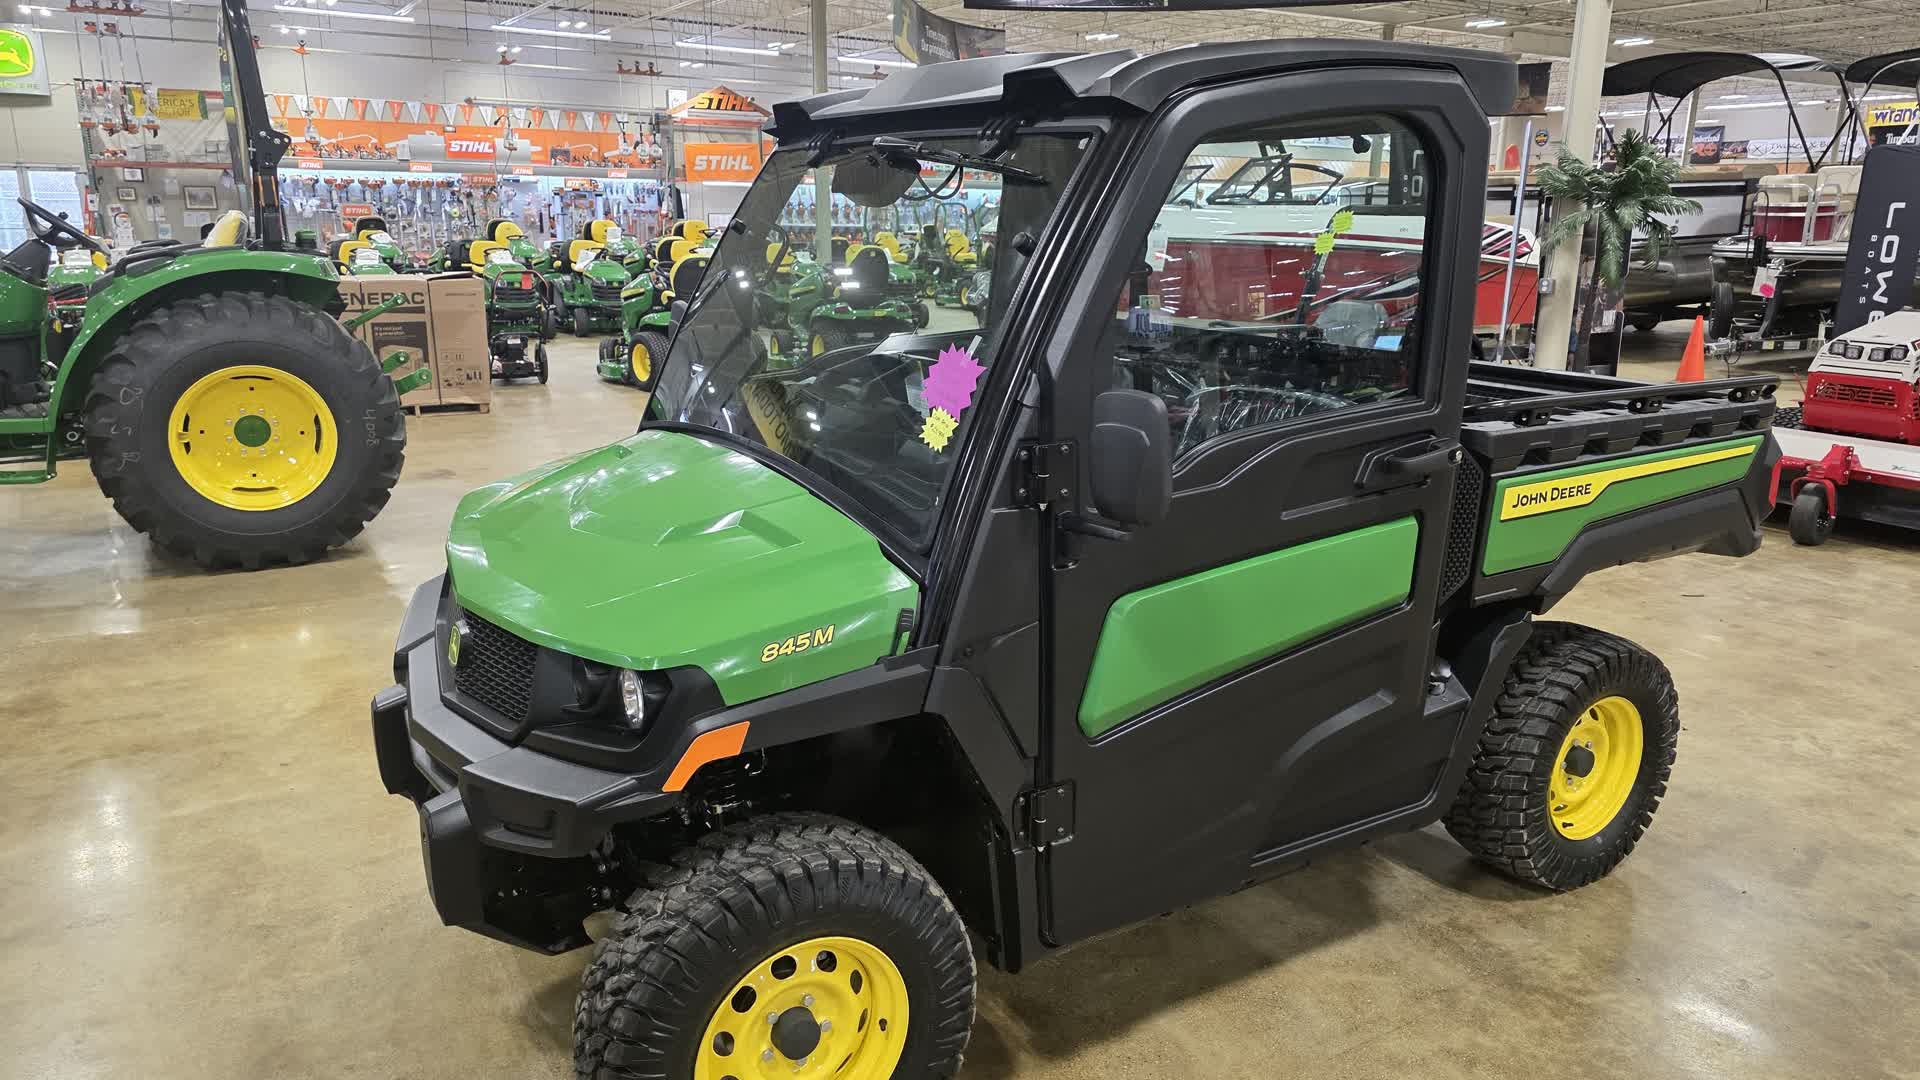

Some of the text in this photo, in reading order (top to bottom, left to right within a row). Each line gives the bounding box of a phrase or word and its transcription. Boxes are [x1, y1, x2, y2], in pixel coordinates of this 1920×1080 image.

[693, 94, 753, 111] STIHL
[449, 140, 494, 153] STIHL
[694, 155, 753, 170] STIHL
[344, 206, 370, 215] STIHL
[1858, 234, 1879, 305] BOATS
[1867, 201, 1907, 326] LOWE
[339, 291, 425, 306] ENERAC
[1512, 484, 1591, 508] JOHN DEERE
[761, 624, 835, 662] 845M
